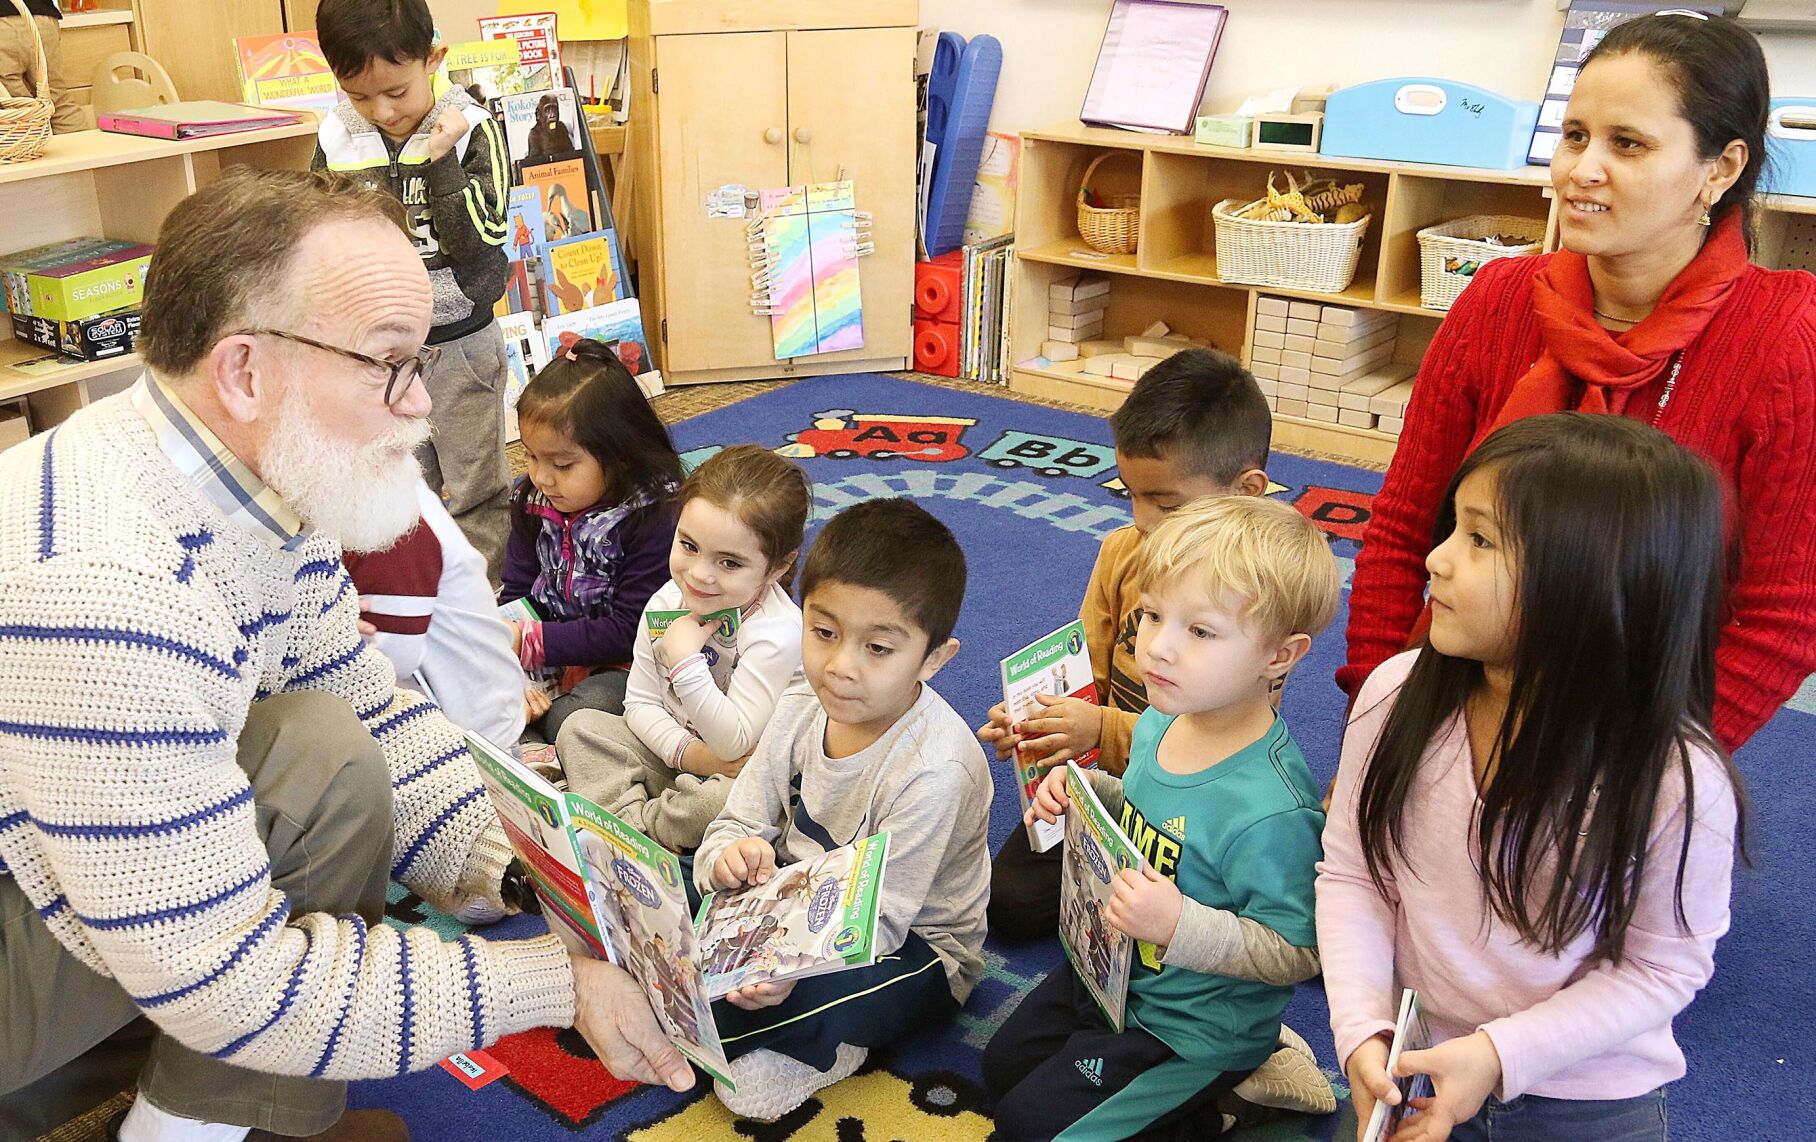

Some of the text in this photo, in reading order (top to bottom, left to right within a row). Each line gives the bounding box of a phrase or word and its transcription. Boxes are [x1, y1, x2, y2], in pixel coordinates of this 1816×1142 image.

[522, 39, 546, 50] PICTURE
[456, 54, 478, 66] TREE
[481, 53, 488, 62] IS
[524, 49, 544, 60] BOOK
[280, 76, 300, 86] WHAT
[263, 84, 332, 100] WONDERFUL WORLD
[508, 98, 537, 112] Koko's
[510, 110, 534, 124] Story
[528, 163, 579, 180] Animal Families
[558, 244, 602, 259] Count Down
[569, 258, 588, 268] Clean
[72, 280, 122, 300] SEASONS
[91, 323, 122, 334] SOLAR
[852, 425, 948, 444] Aa
[1007, 440, 1100, 467] Bb
[1312, 502, 1371, 524] D
[1010, 642, 1064, 676] World of Reading
[501, 770, 532, 802] Reading
[571, 801, 650, 858] World of Reading
[1090, 808, 1114, 848] Reading
[1162, 822, 1185, 841] adidas
[1083, 838, 1107, 876] FROZEN
[616, 864, 655, 902] FROZEN
[850, 840, 879, 920] World of Reading
[812, 884, 833, 927] FROZEN
[1074, 1060, 1102, 1086] adidas
